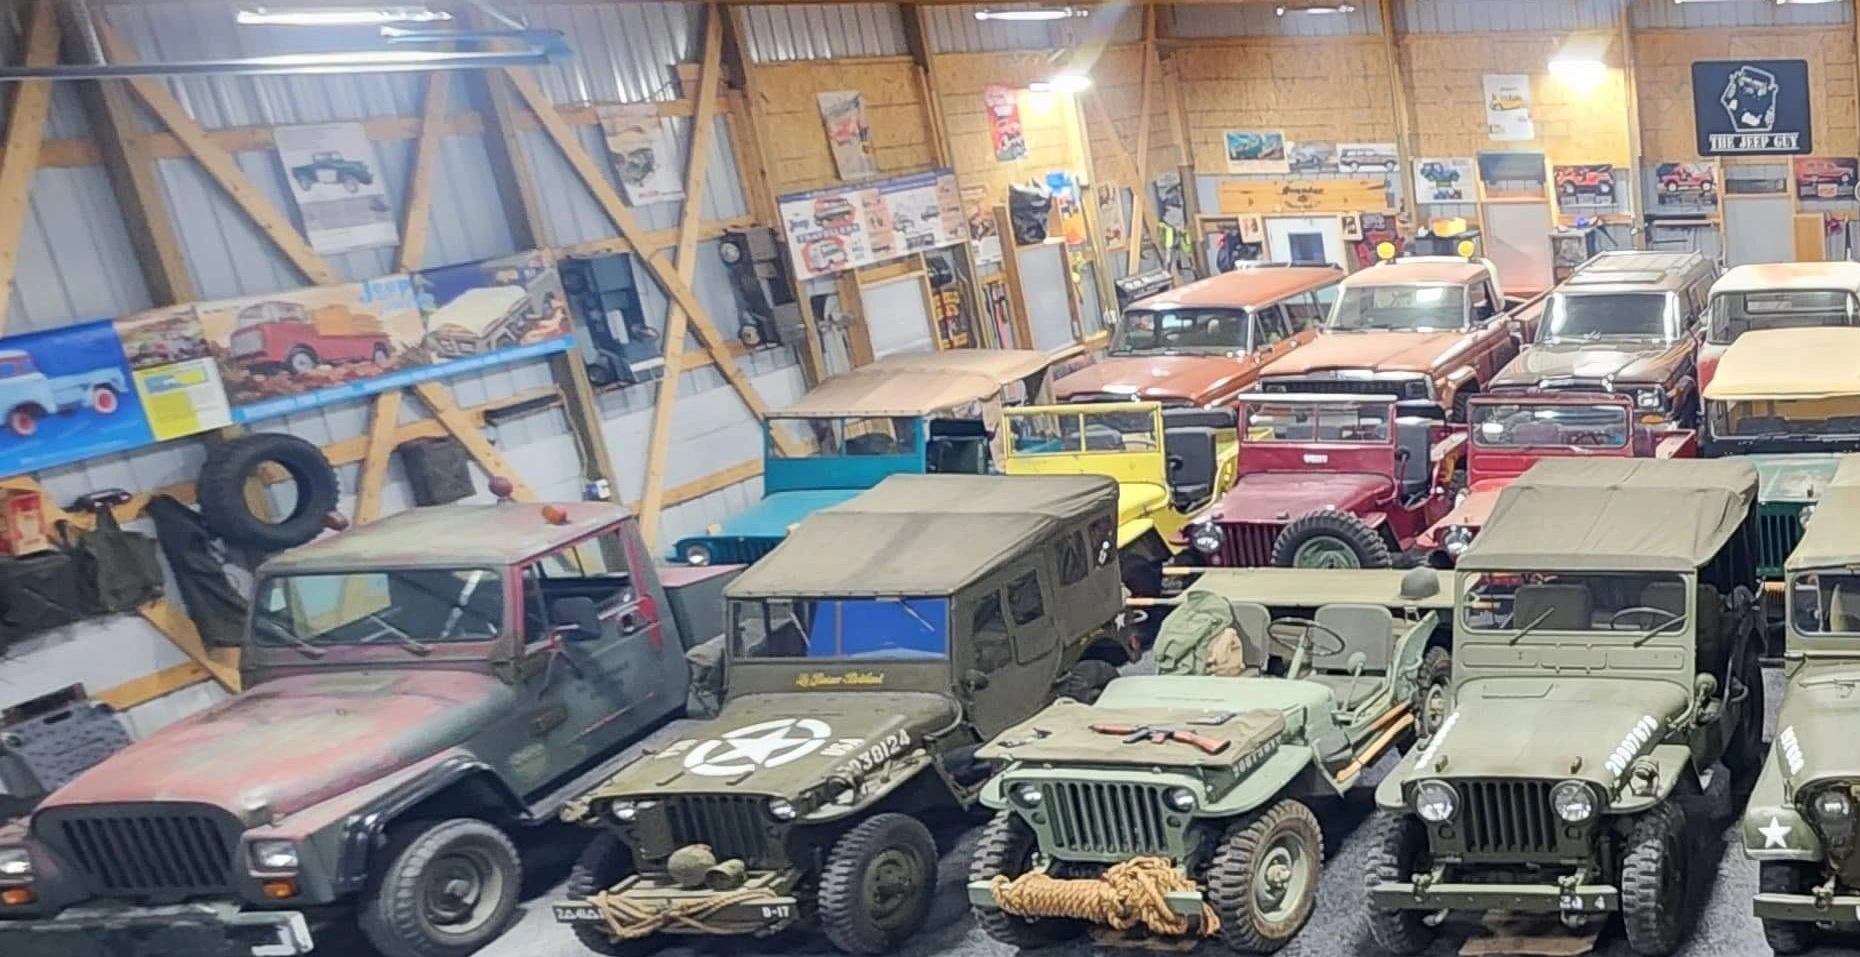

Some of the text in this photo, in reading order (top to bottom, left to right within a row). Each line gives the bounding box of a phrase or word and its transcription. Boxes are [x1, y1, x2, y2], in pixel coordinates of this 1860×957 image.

[1709, 131, 1800, 151] THE JEEP GUY
